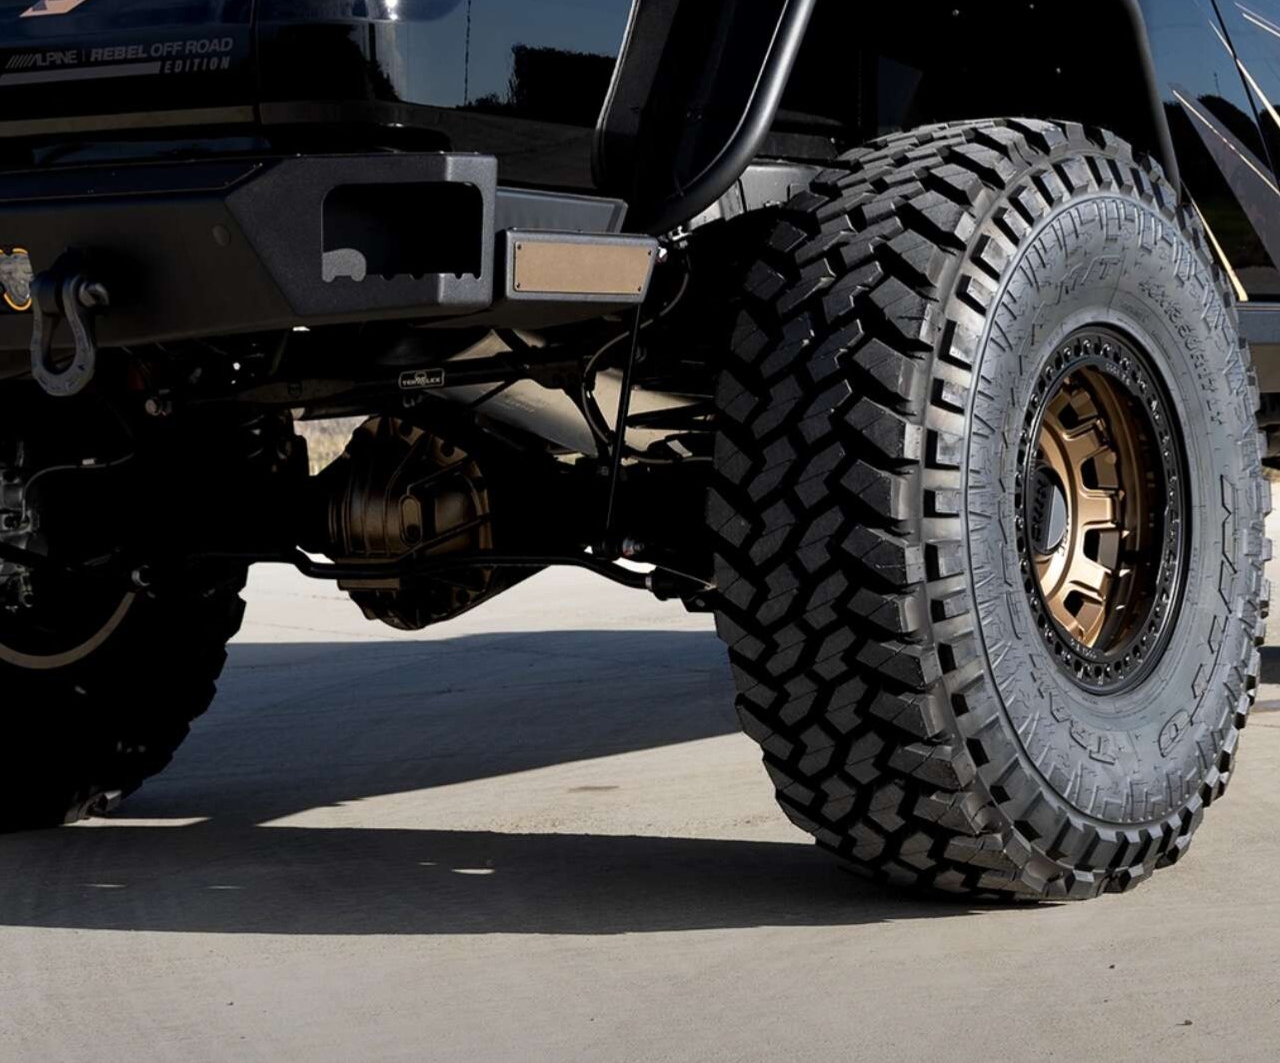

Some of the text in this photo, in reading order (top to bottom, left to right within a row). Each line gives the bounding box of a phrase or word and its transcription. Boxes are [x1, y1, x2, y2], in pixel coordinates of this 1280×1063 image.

[90, 45, 148, 62] REBEL
[150, 41, 183, 57] OFF
[185, 37, 233, 54] ROAD
[164, 56, 231, 74] EDITION
